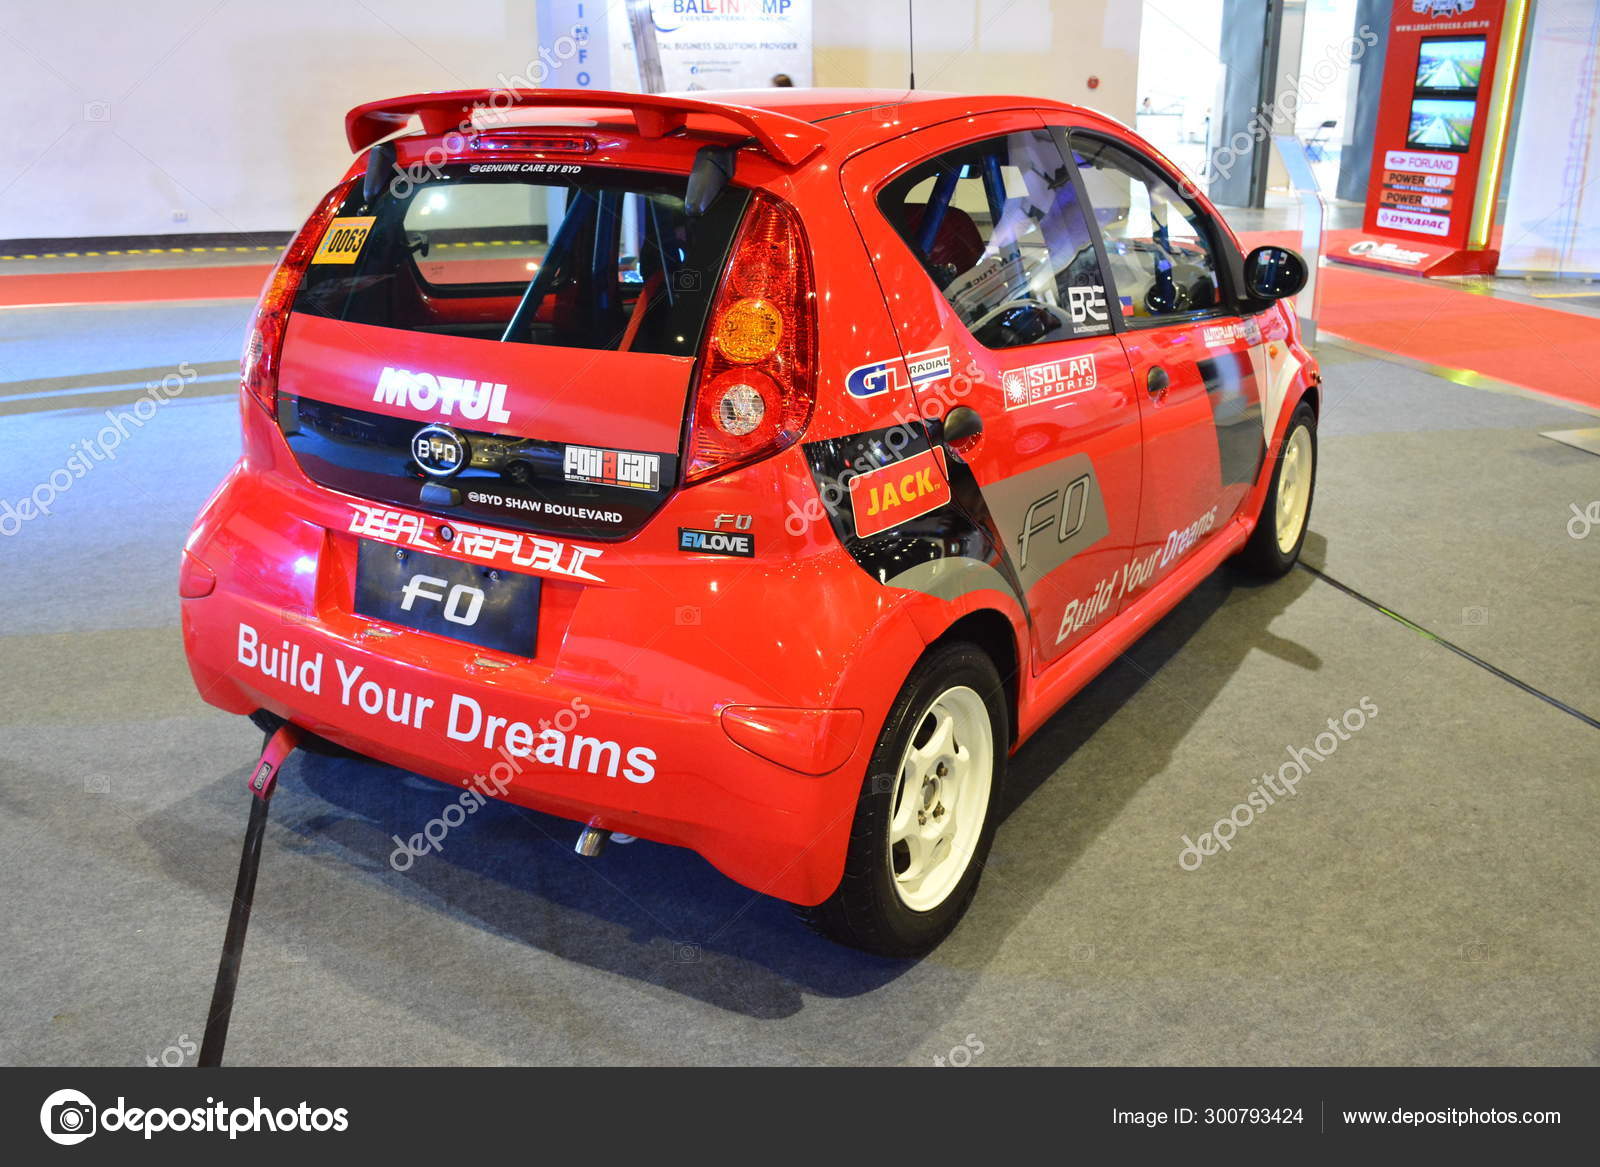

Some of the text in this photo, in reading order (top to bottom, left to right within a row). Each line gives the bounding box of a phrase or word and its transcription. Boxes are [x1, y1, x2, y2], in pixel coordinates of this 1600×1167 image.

[480, 164, 581, 174] GENUINE CARE BY BYD
[1408, 157, 1454, 171] FORLAND
[1390, 215, 1446, 230] DYNAPAC
[328, 229, 367, 253] 0063
[909, 357, 950, 375] RADIAL
[1030, 358, 1093, 387] SOLAR
[373, 367, 511, 424] MOTUL
[1031, 375, 1094, 399] SPORTS
[418, 439, 456, 463] BYD
[867, 467, 934, 516] JACK
[479, 494, 623, 523] BYD SHAW BOULEVARD
[1056, 506, 1218, 645] Build Your Dreams
[237, 623, 657, 784] Build Your Dreams
